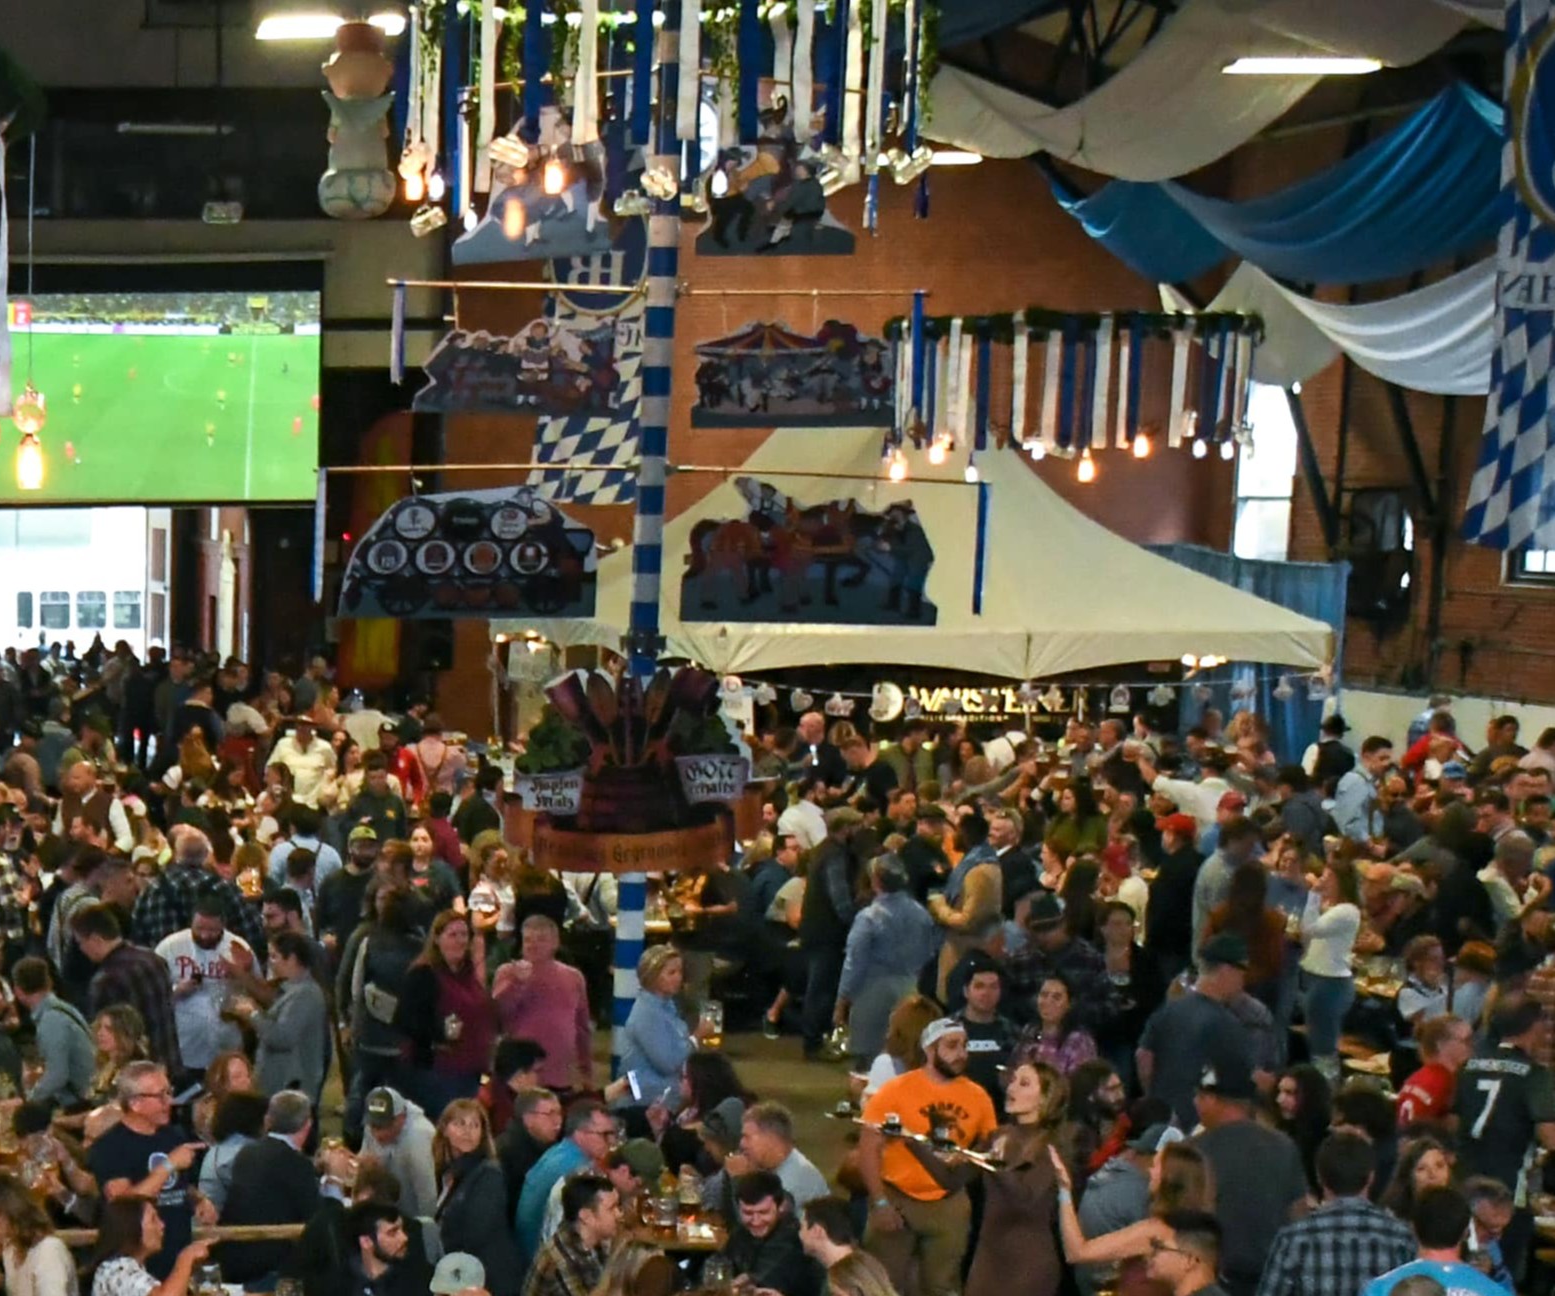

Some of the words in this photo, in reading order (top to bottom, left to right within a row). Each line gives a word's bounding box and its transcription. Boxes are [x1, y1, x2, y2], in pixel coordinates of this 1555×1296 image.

[908, 685, 1086, 713] WARSTER
[175, 954, 226, 979] Phill
[1470, 1079, 1502, 1139] 7
